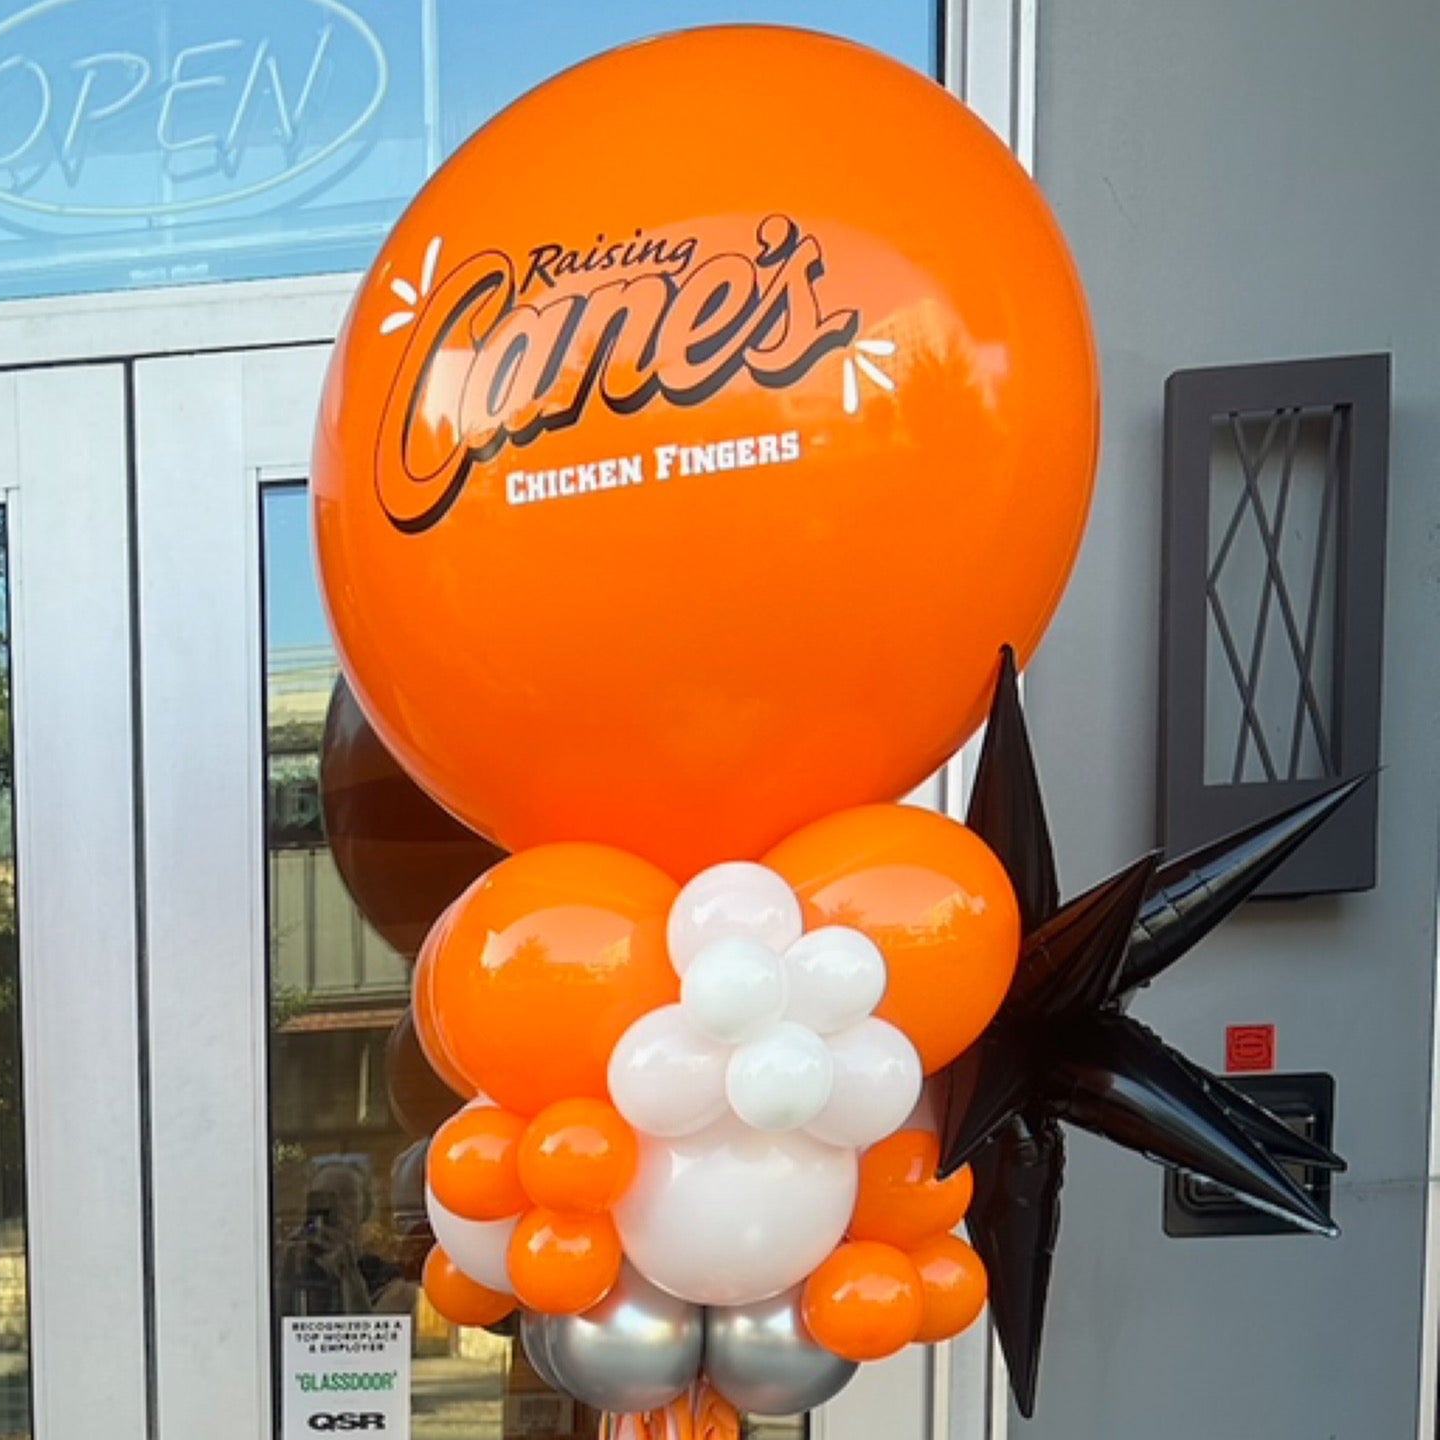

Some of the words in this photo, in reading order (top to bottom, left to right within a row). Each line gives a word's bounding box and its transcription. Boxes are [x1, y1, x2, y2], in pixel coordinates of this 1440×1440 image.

[519, 228, 698, 295] Raising
[374, 213, 859, 534] Cane's
[292, 1321, 371, 1331] RECOGNIZED
[295, 1333, 319, 1342] TOP
[308, 1412, 386, 1431] QSR
